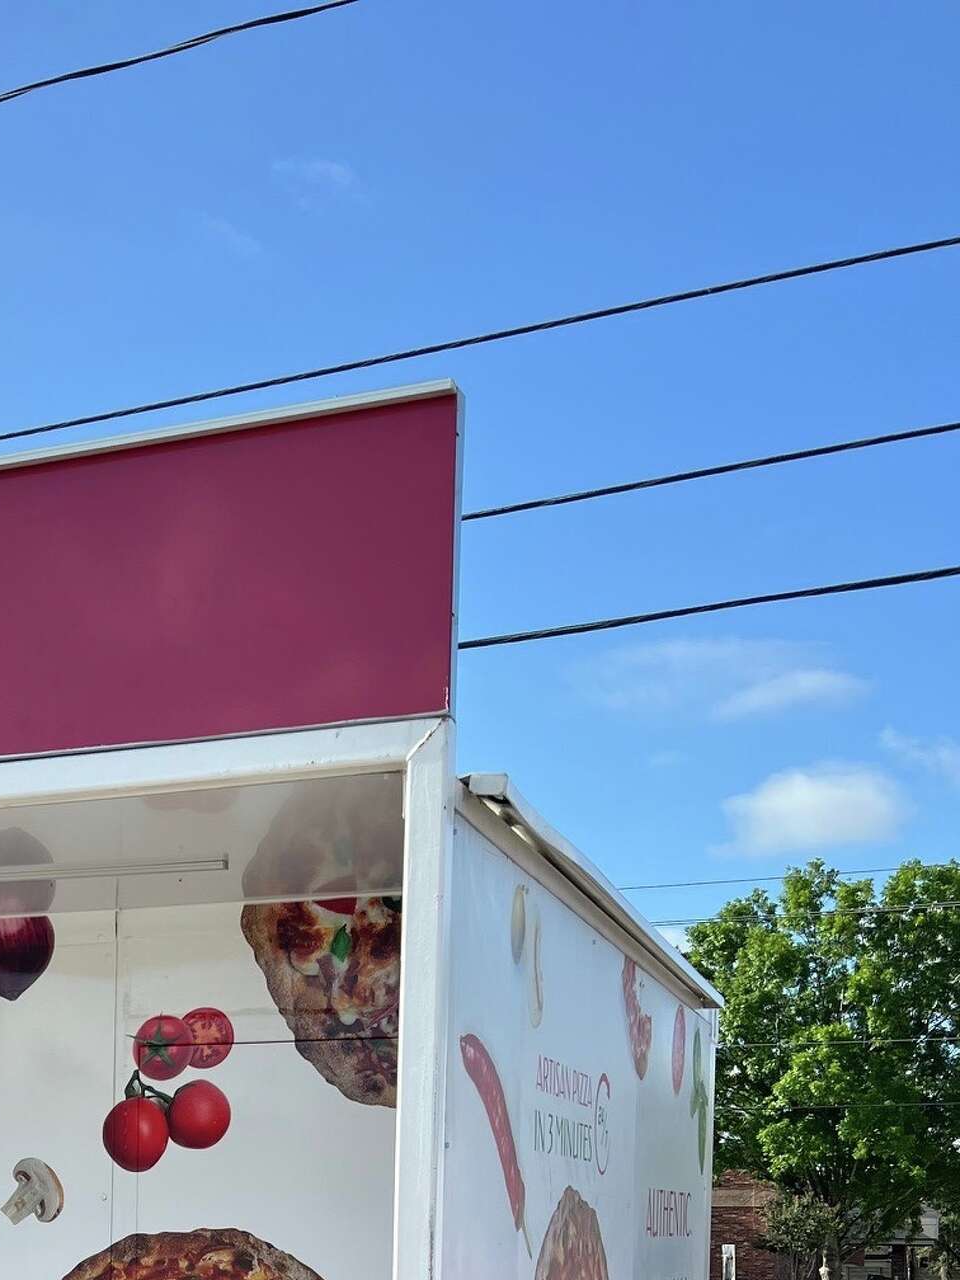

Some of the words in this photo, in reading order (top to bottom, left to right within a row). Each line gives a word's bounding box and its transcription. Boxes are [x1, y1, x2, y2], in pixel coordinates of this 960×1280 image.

[536, 1054, 572, 1102] ARTISAN
[572, 1069, 593, 1109] PIZZA
[534, 1109, 546, 1152] IN
[547, 1113, 554, 1155] 3
[555, 1115, 593, 1163] MINUTES
[645, 1187, 692, 1238] AUTHENTIC
